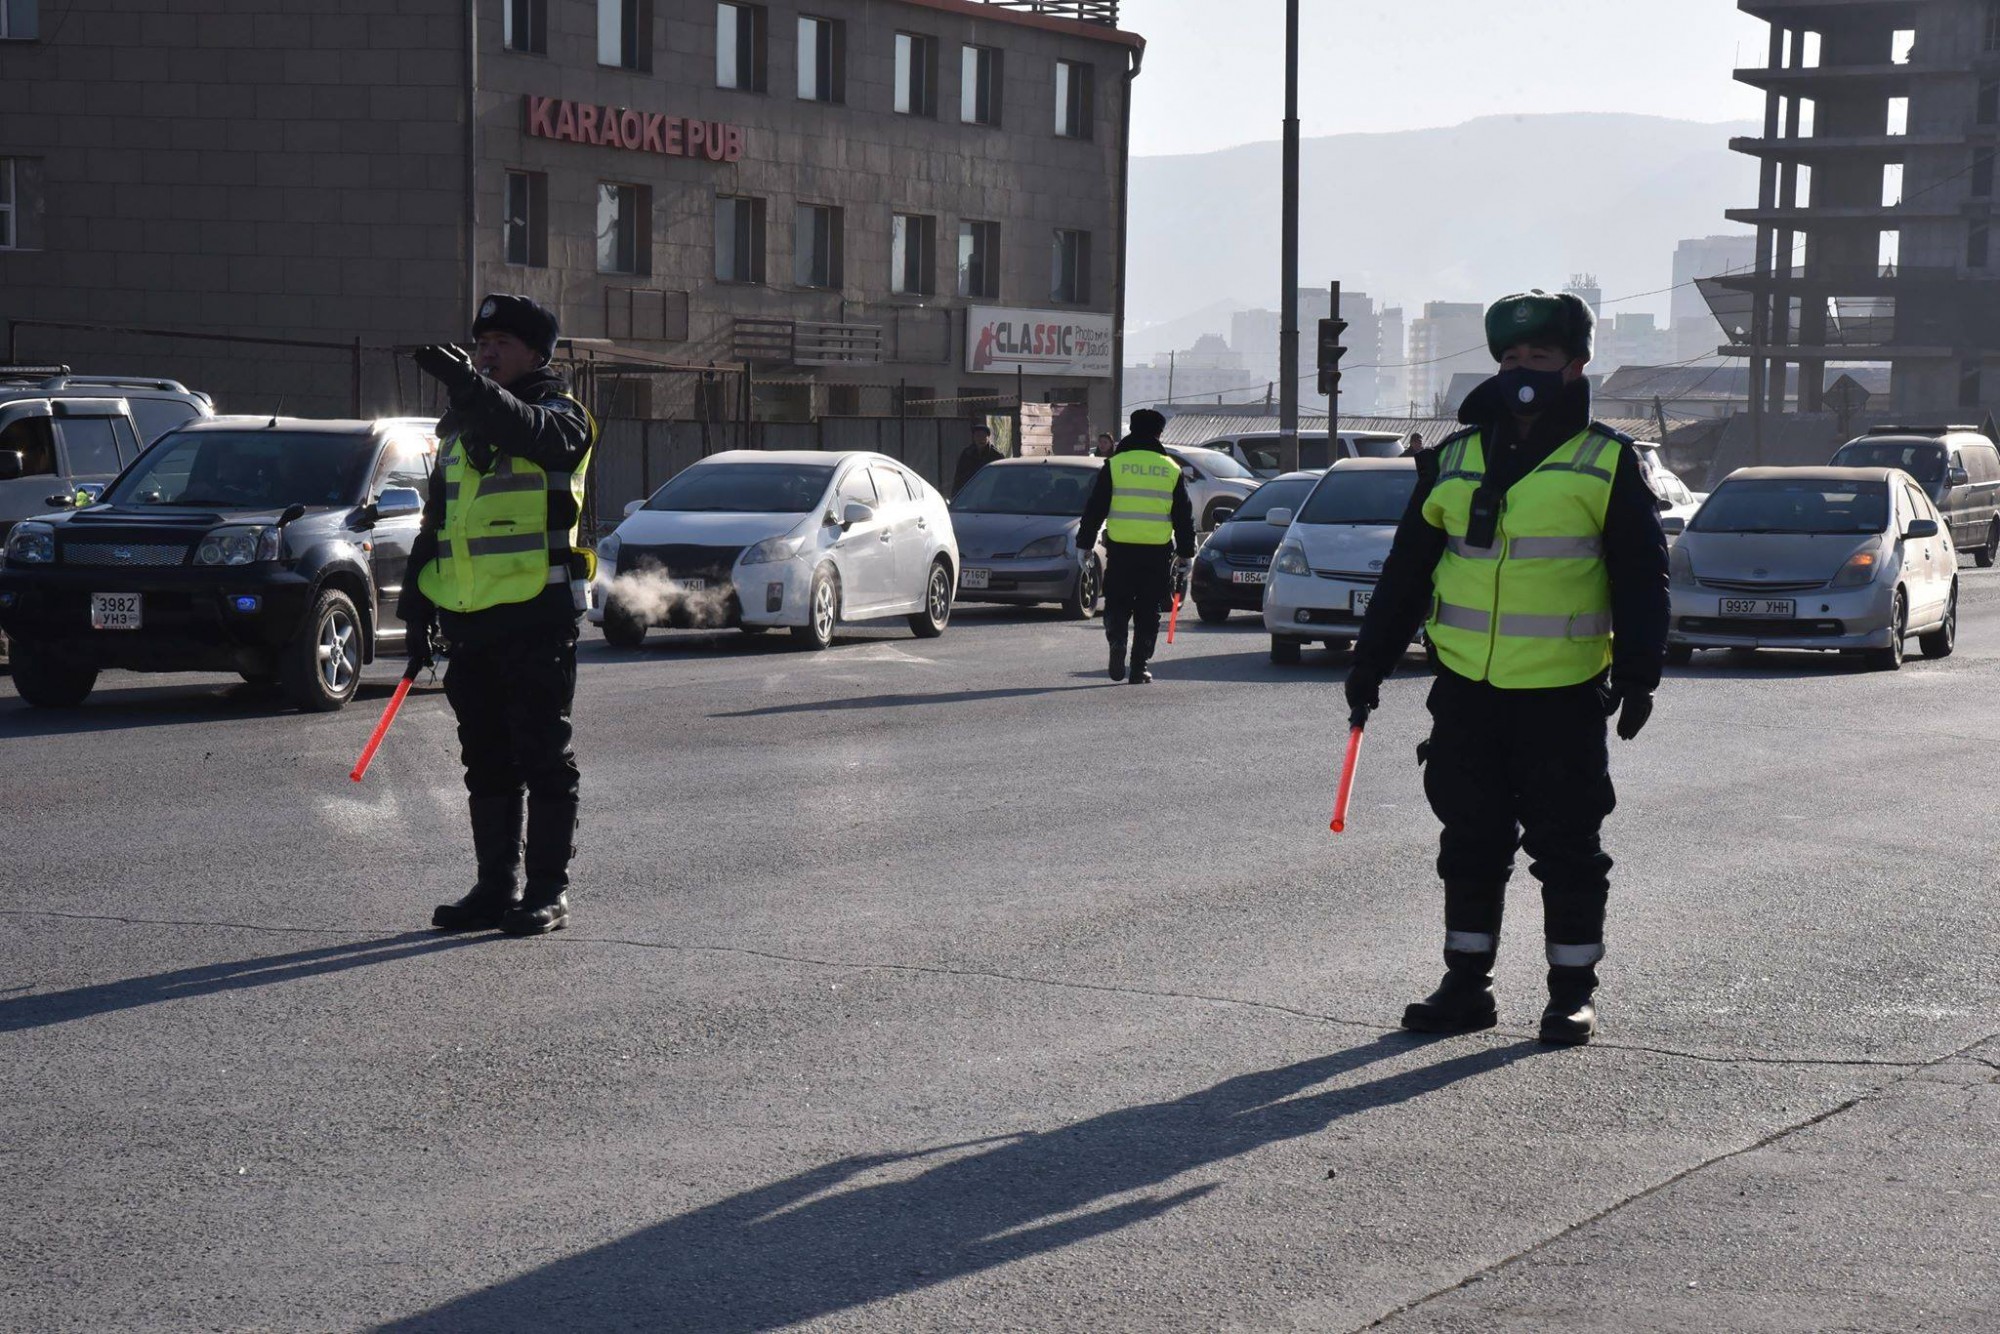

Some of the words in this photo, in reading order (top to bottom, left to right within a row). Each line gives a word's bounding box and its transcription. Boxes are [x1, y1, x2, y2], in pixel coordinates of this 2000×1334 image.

[524, 94, 683, 156] KARAOKE
[687, 118, 743, 162] PUB
[996, 321, 1072, 356] CLASSIC
[1120, 463, 1169, 477] POLICE
[99, 597, 135, 612] 3982
[1726, 600, 1756, 613] 9937
